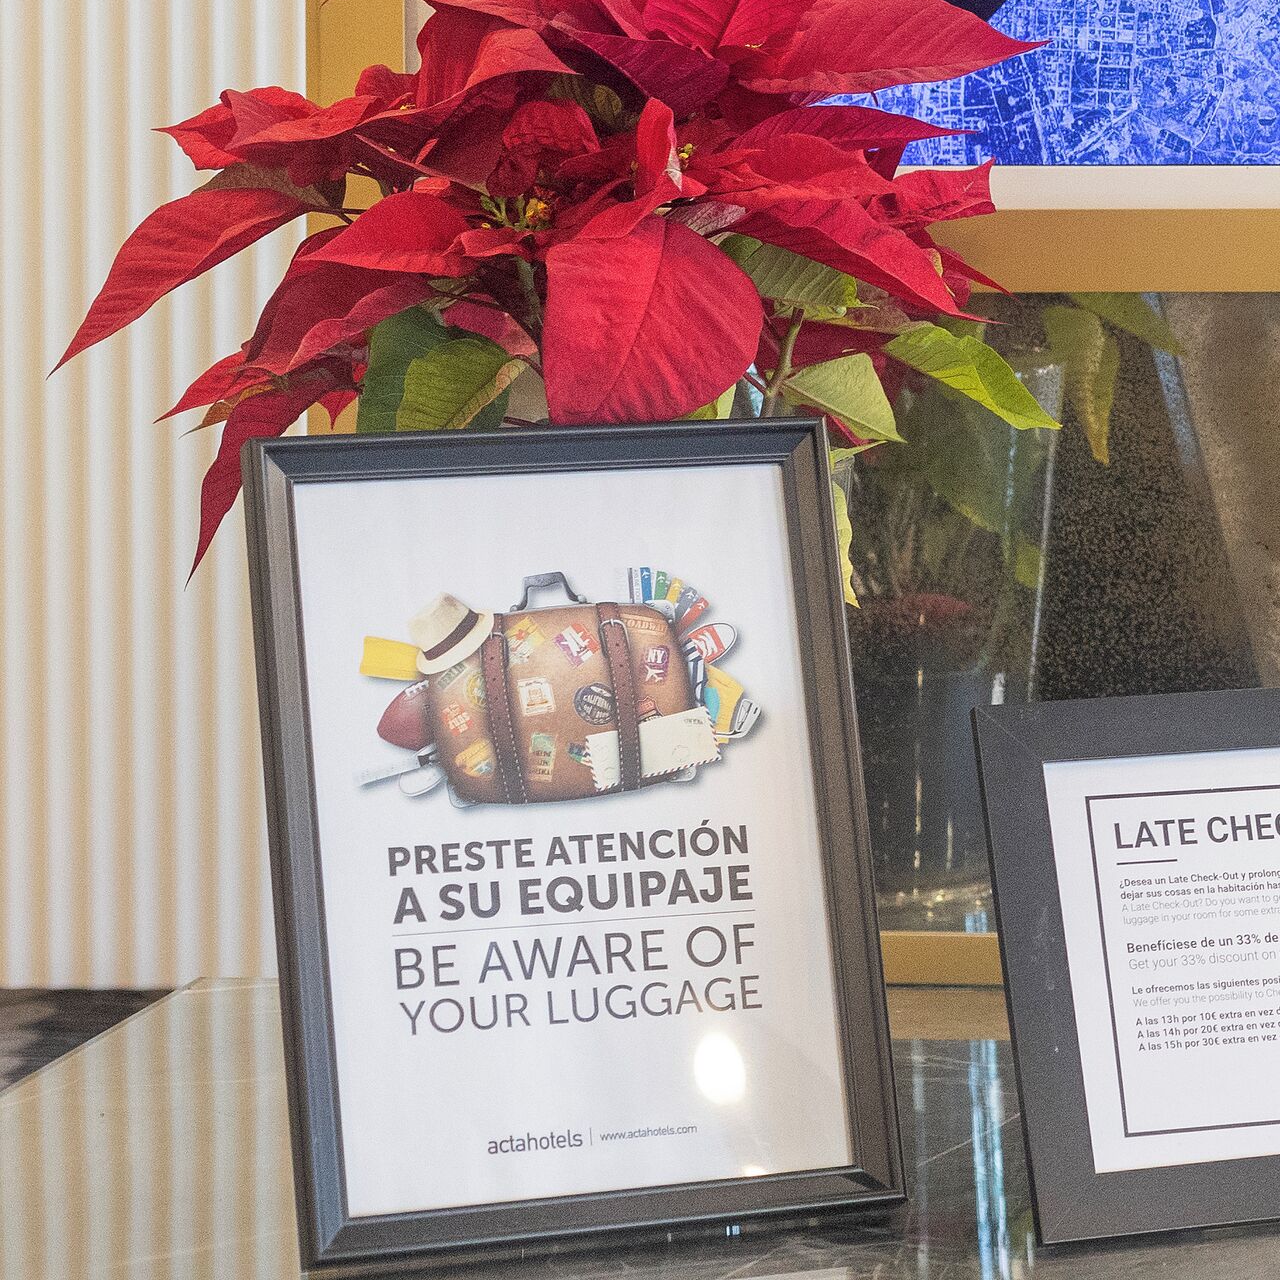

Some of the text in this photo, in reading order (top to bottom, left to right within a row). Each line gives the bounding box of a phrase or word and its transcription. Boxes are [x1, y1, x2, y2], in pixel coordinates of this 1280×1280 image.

[647, 649, 666, 664] NY
[1115, 818, 1197, 849] LATE
[388, 819, 749, 877] PRESTE ATENCIÓN
[1119, 877, 1153, 889] ¿Desea
[1168, 874, 1189, 884] Late
[1190, 871, 1239, 882] Check-Out
[1241, 873, 1247, 881] y
[393, 864, 754, 925] A SU EQUIPAJE
[1120, 890, 1144, 901] dejar
[1146, 890, 1162, 898] sus
[1164, 888, 1192, 896] cosas
[1207, 885, 1216, 893] la
[1217, 882, 1265, 893] habitación
[1127, 937, 1198, 953] Benefíciese
[1200, 936, 1216, 948] de
[1218, 938, 1234, 947] un
[1236, 933, 1262, 946] 33%
[1264, 932, 1279, 944] de
[394, 923, 756, 991] BE AWARE OF
[1128, 957, 1149, 969] Get
[1153, 958, 1178, 970] your
[1181, 954, 1206, 966] 33%
[1209, 950, 1258, 964] discount
[1262, 952, 1277, 961] on
[1131, 985, 1144, 994] Le
[1145, 981, 1195, 994] ofrecemos
[1196, 980, 1211, 990] las
[1212, 977, 1260, 991] siguientes
[400, 975, 763, 1036] YOUR LUGGAGE
[1135, 1017, 1143, 1025] A
[1144, 1016, 1159, 1025] las
[1161, 1015, 1180, 1024] 13h
[1181, 1015, 1198, 1024] por
[1199, 1012, 1217, 1021] 10€
[1219, 1010, 1243, 1020] extra
[1137, 1030, 1145, 1038] A
[1146, 1029, 1161, 1038] las
[1162, 1028, 1181, 1036] 14h
[1183, 1028, 1199, 1037] por
[1200, 1025, 1219, 1034] 20€
[1220, 1023, 1244, 1032] extra
[1138, 1042, 1146, 1051] A
[1148, 1041, 1162, 1050] las
[1165, 1040, 1183, 1049] 15h
[1184, 1041, 1201, 1049] por
[1202, 1038, 1220, 1046] 30€
[1222, 1036, 1246, 1045] extra
[1261, 1035, 1277, 1043] vez
[487, 1129, 584, 1155] actahotels
[599, 1124, 698, 1142] www.actahotels.com
